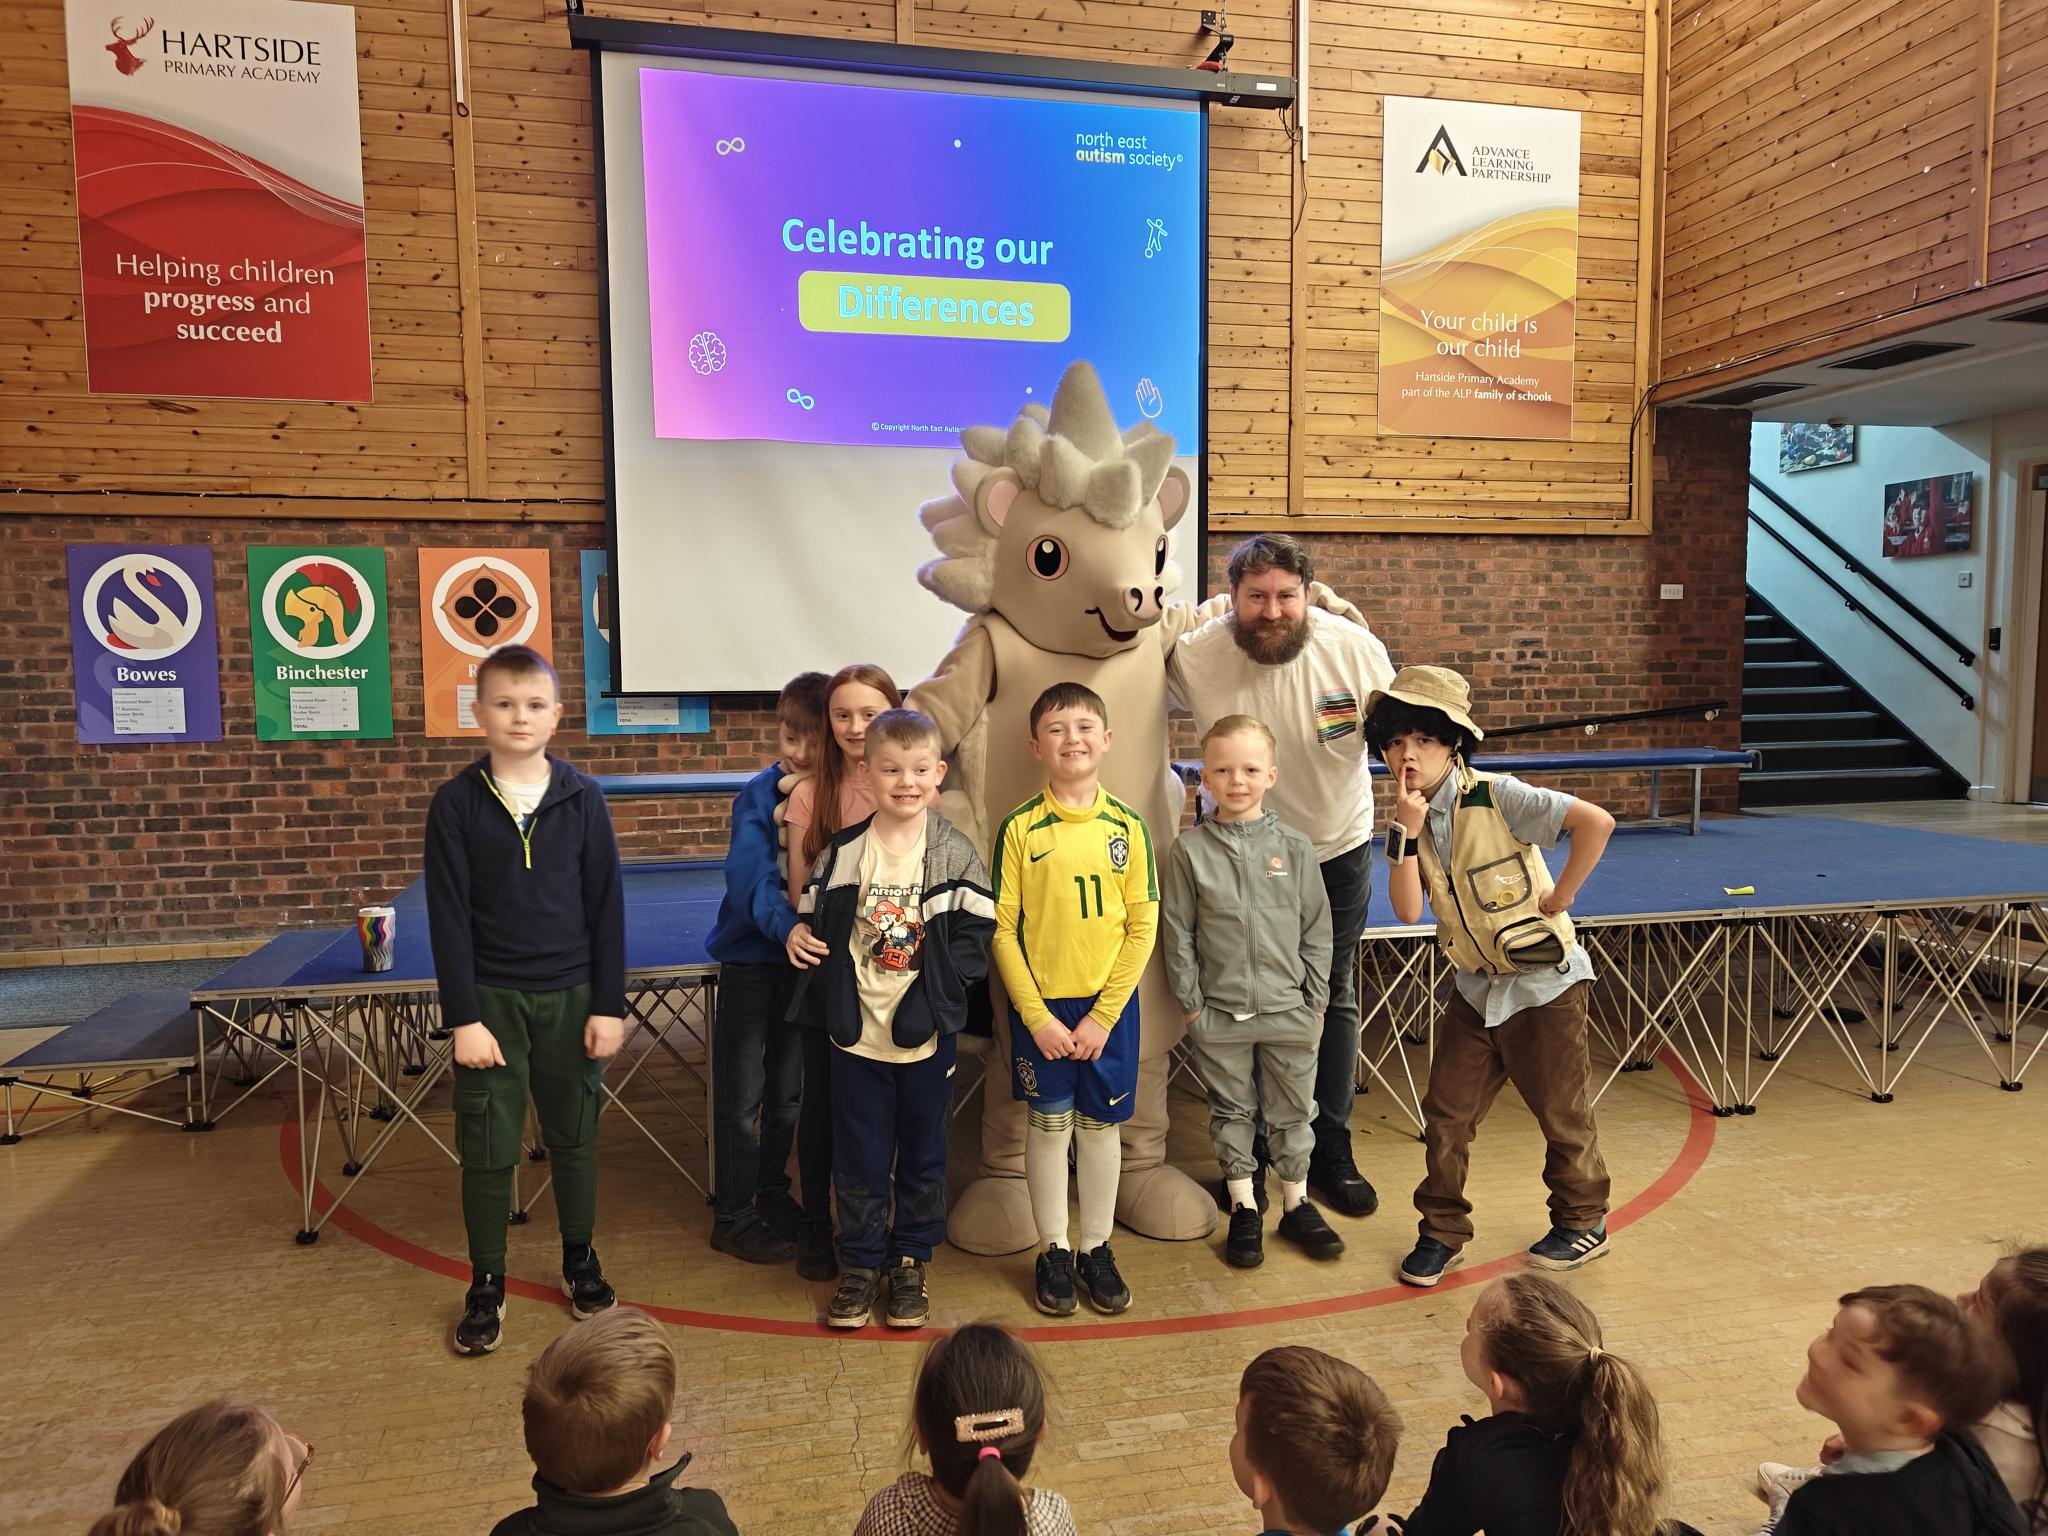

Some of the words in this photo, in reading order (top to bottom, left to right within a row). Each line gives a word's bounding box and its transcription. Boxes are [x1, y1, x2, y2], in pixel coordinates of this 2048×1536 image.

[162, 29, 321, 66] HARTSIDE
[164, 60, 236, 78] PRIMARY
[241, 67, 321, 84] ACADEMY
[1076, 131, 1114, 148] north
[1117, 135, 1148, 150] east
[1075, 147, 1125, 164] autism
[1472, 145, 1530, 160] ADVANCE
[1472, 157, 1534, 171] LEARNING
[1472, 168, 1551, 183] PARTNERSHIP
[782, 218, 985, 270] Celebrating
[995, 236, 1054, 265] our
[116, 253, 222, 287] Helping
[229, 258, 335, 285] children
[144, 291, 256, 316] progress
[263, 292, 311, 314] and
[838, 284, 1035, 328] Differences
[1420, 309, 1466, 330] Your
[1471, 312, 1518, 333] child
[1524, 315, 1538, 334] is
[177, 320, 282, 344] succeed
[1436, 341, 1468, 356] our
[1474, 337, 1520, 358] child
[1415, 371, 1456, 382] Hartside
[1458, 373, 1495, 386] Primary
[1496, 375, 1539, 388] Academy
[1401, 388, 1420, 399] part
[1423, 387, 1434, 397] of
[1435, 388, 1451, 397] the
[1452, 389, 1472, 399] ALP
[1474, 389, 1503, 402] family
[1506, 390, 1517, 400] of
[1518, 391, 1552, 402] schools
[880, 423, 910, 432] Copyright
[911, 424, 929, 432] North
[944, 425, 964, 433] Autis
[116, 666, 177, 682] Bowes
[276, 664, 369, 680] Binchester
[1073, 874, 1104, 919] 11
